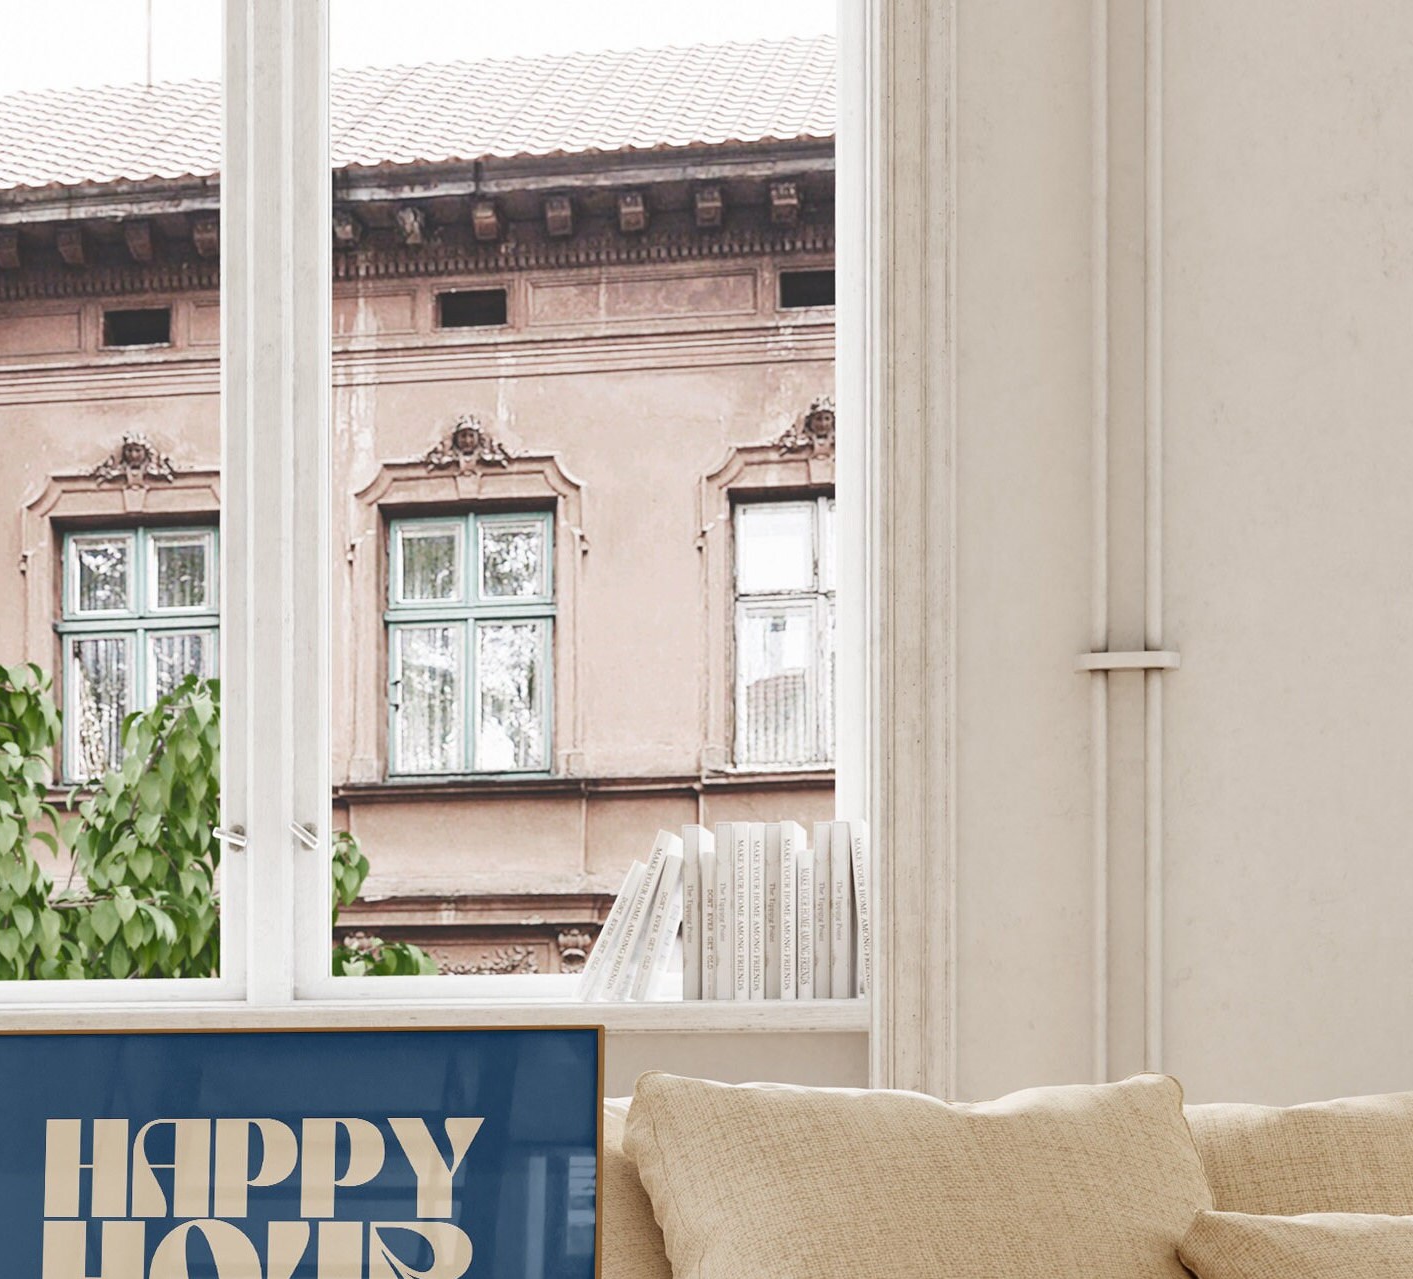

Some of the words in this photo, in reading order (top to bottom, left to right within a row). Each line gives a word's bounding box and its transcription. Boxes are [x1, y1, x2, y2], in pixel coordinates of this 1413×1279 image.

[649, 847, 662, 870] MAKE
[783, 839, 791, 863] MAKE
[854, 837, 862, 860] MAKE
[642, 871, 654, 895] YOUR
[783, 864, 791, 888] YOUR
[800, 868, 810, 886] MAKE
[856, 863, 864, 887] YOUR
[634, 895, 645, 921] HOME
[783, 891, 791, 917] HOME
[858, 889, 867, 916] HOME
[619, 922, 635, 954] AMONG
[783, 920, 791, 951] AMONG
[862, 918, 870, 950] AMONG
[607, 955, 623, 990] FRIENDS
[783, 954, 791, 990] FRIENDS
[44, 1117, 485, 1218] HAPPY
